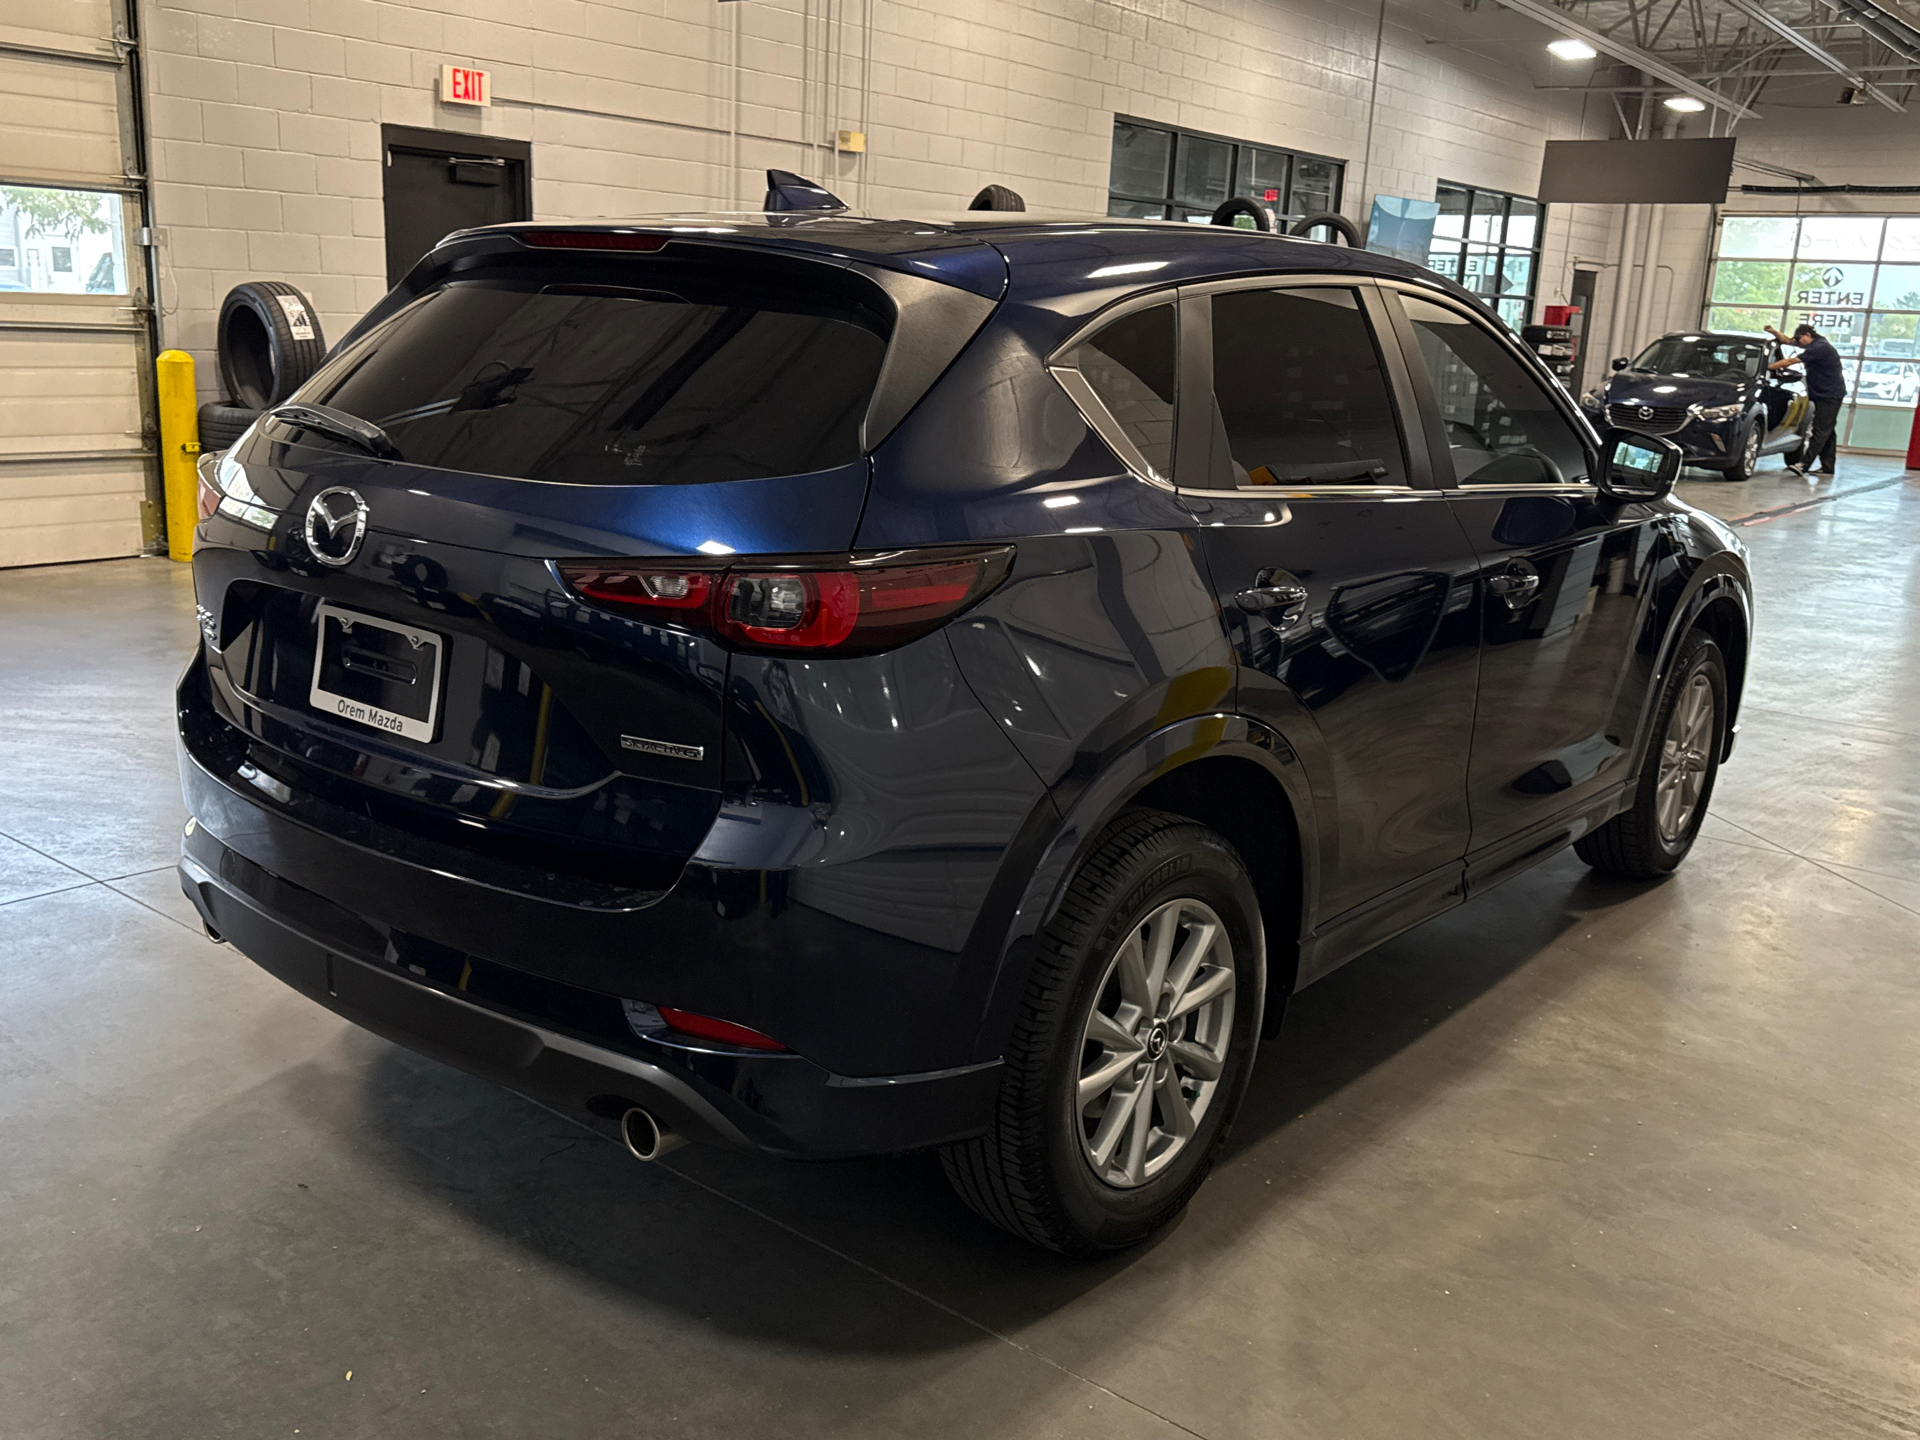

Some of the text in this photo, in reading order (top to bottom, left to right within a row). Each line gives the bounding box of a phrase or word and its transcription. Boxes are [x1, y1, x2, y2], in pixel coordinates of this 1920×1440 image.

[452, 68, 484, 102] EXIT
[337, 699, 403, 732] Orem Mazda
